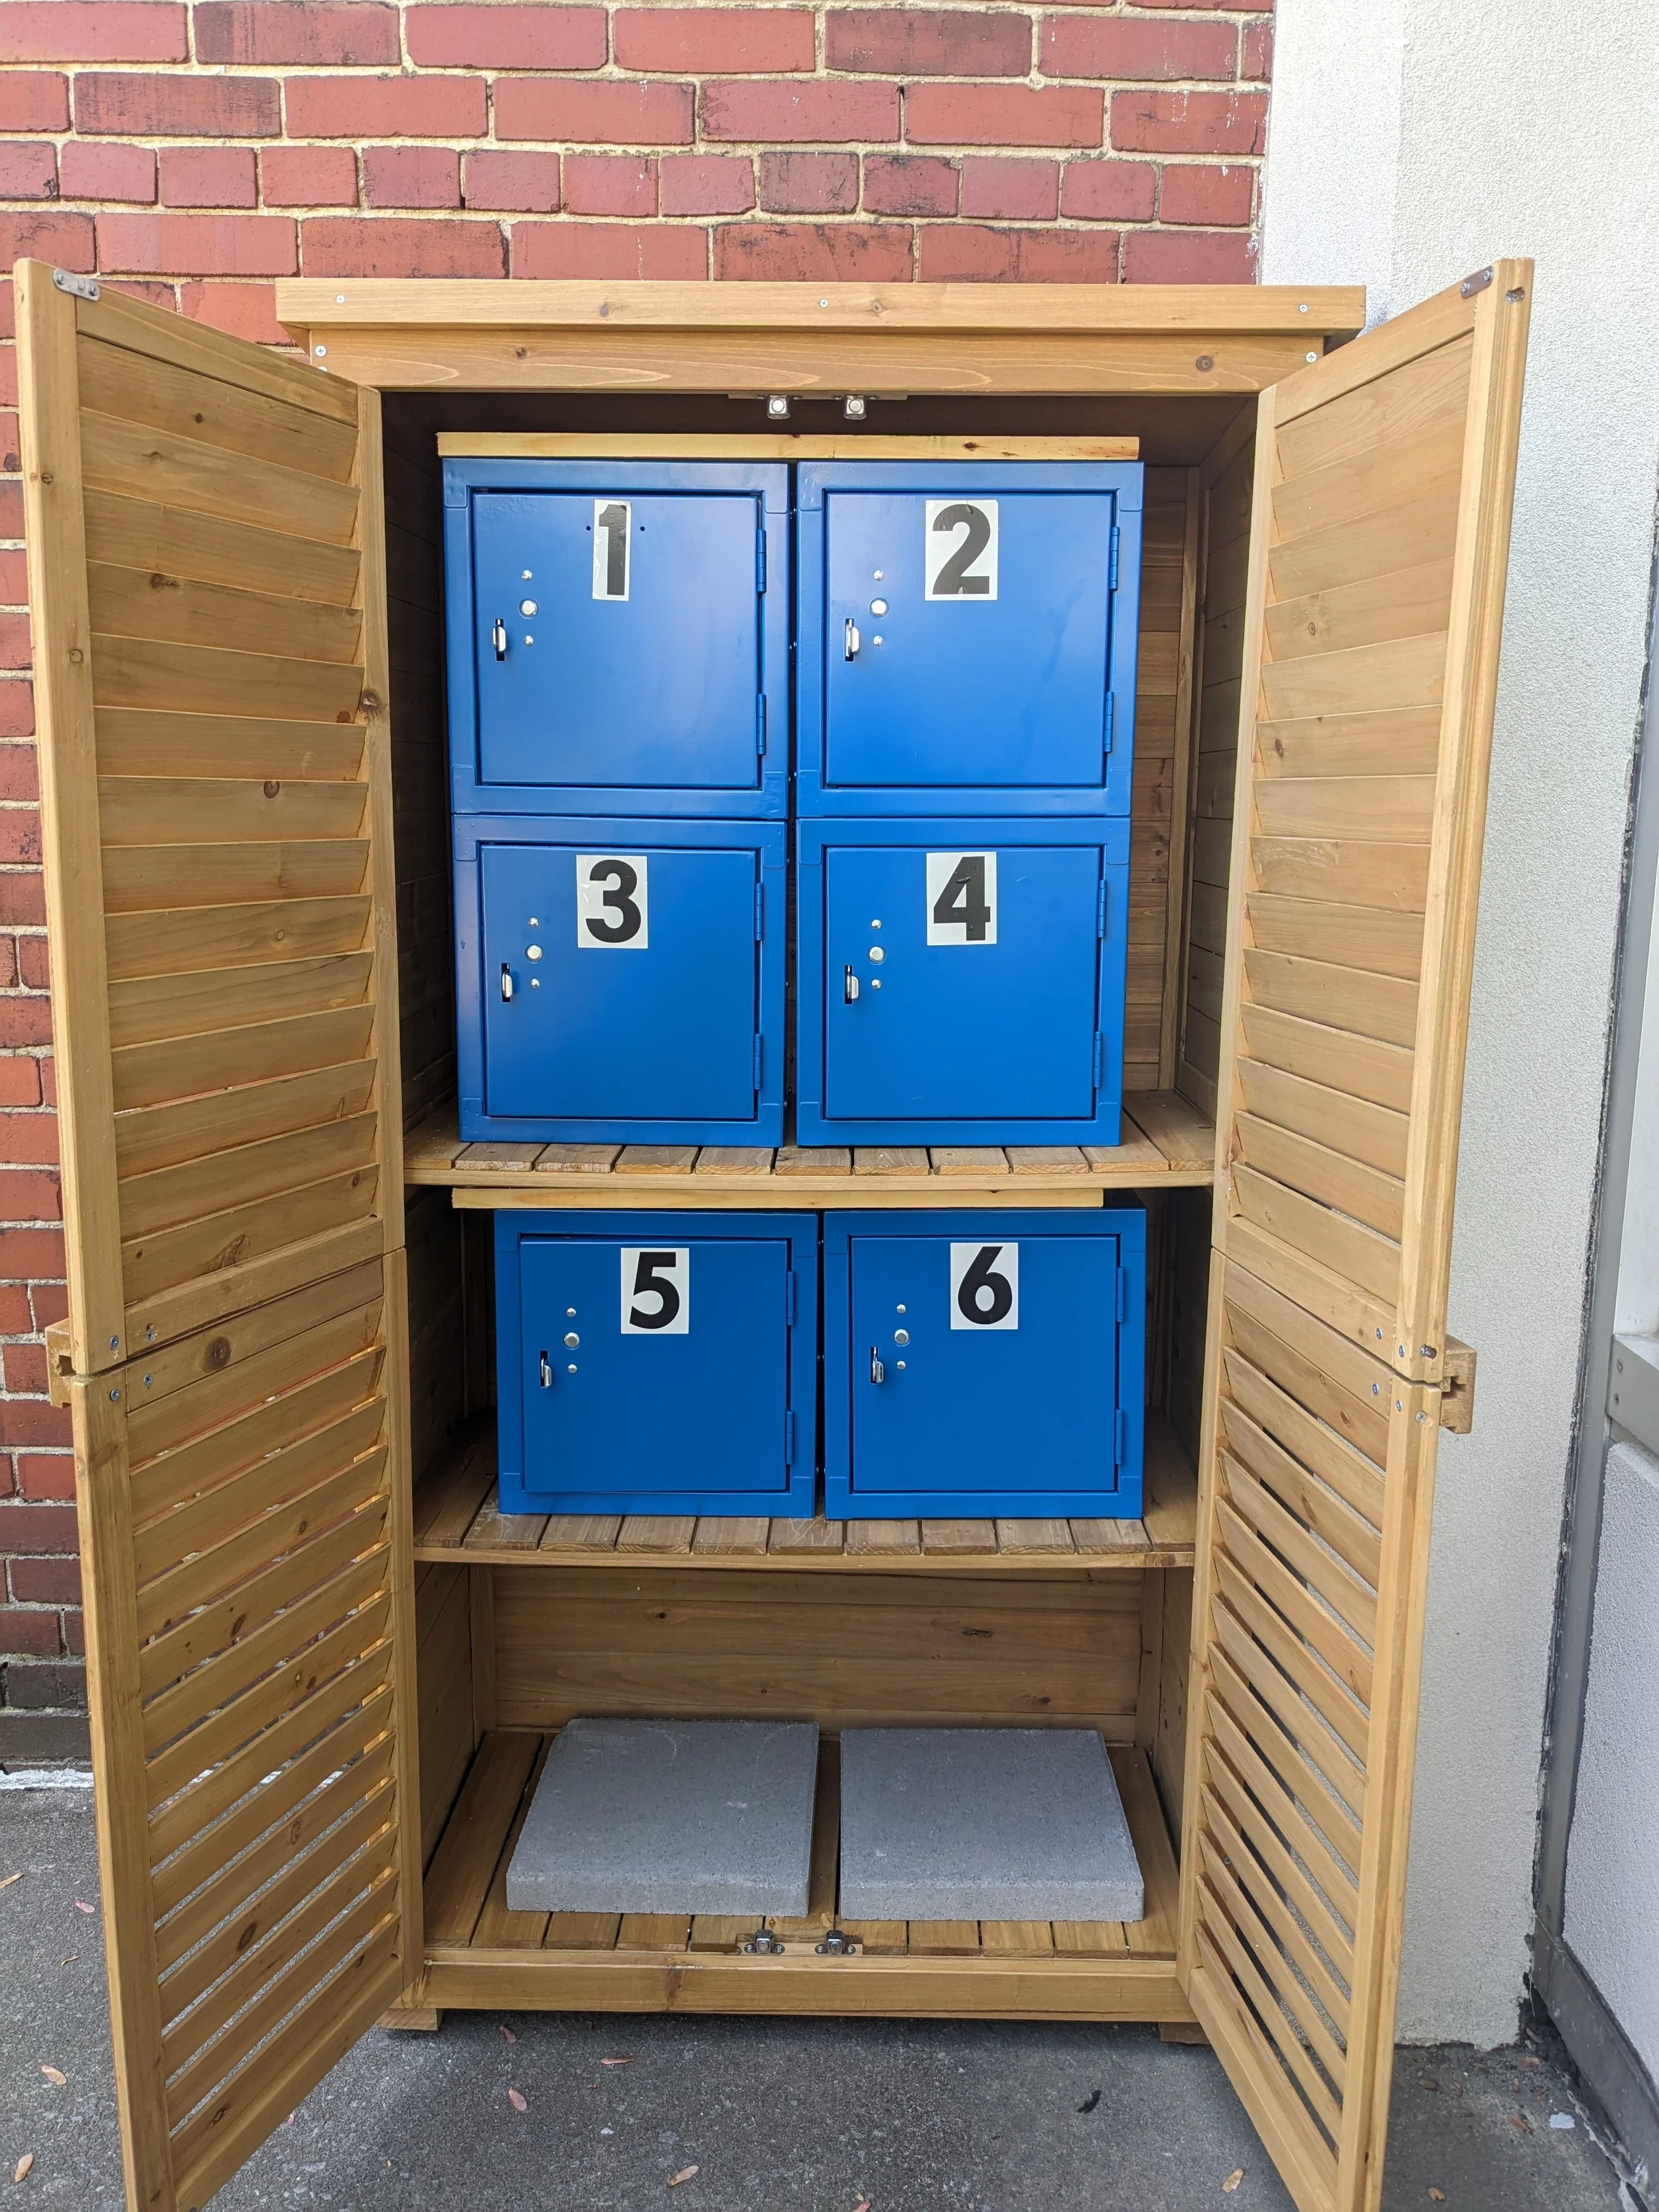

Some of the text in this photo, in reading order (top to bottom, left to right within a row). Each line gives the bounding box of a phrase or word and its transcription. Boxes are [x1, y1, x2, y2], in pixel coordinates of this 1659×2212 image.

[599, 504, 627, 595] 1
[932, 504, 991, 595] 2
[585, 859, 642, 943] 3
[933, 856, 991, 941] 4
[629, 1252, 680, 1329] 5
[958, 1246, 1013, 1325] 6
